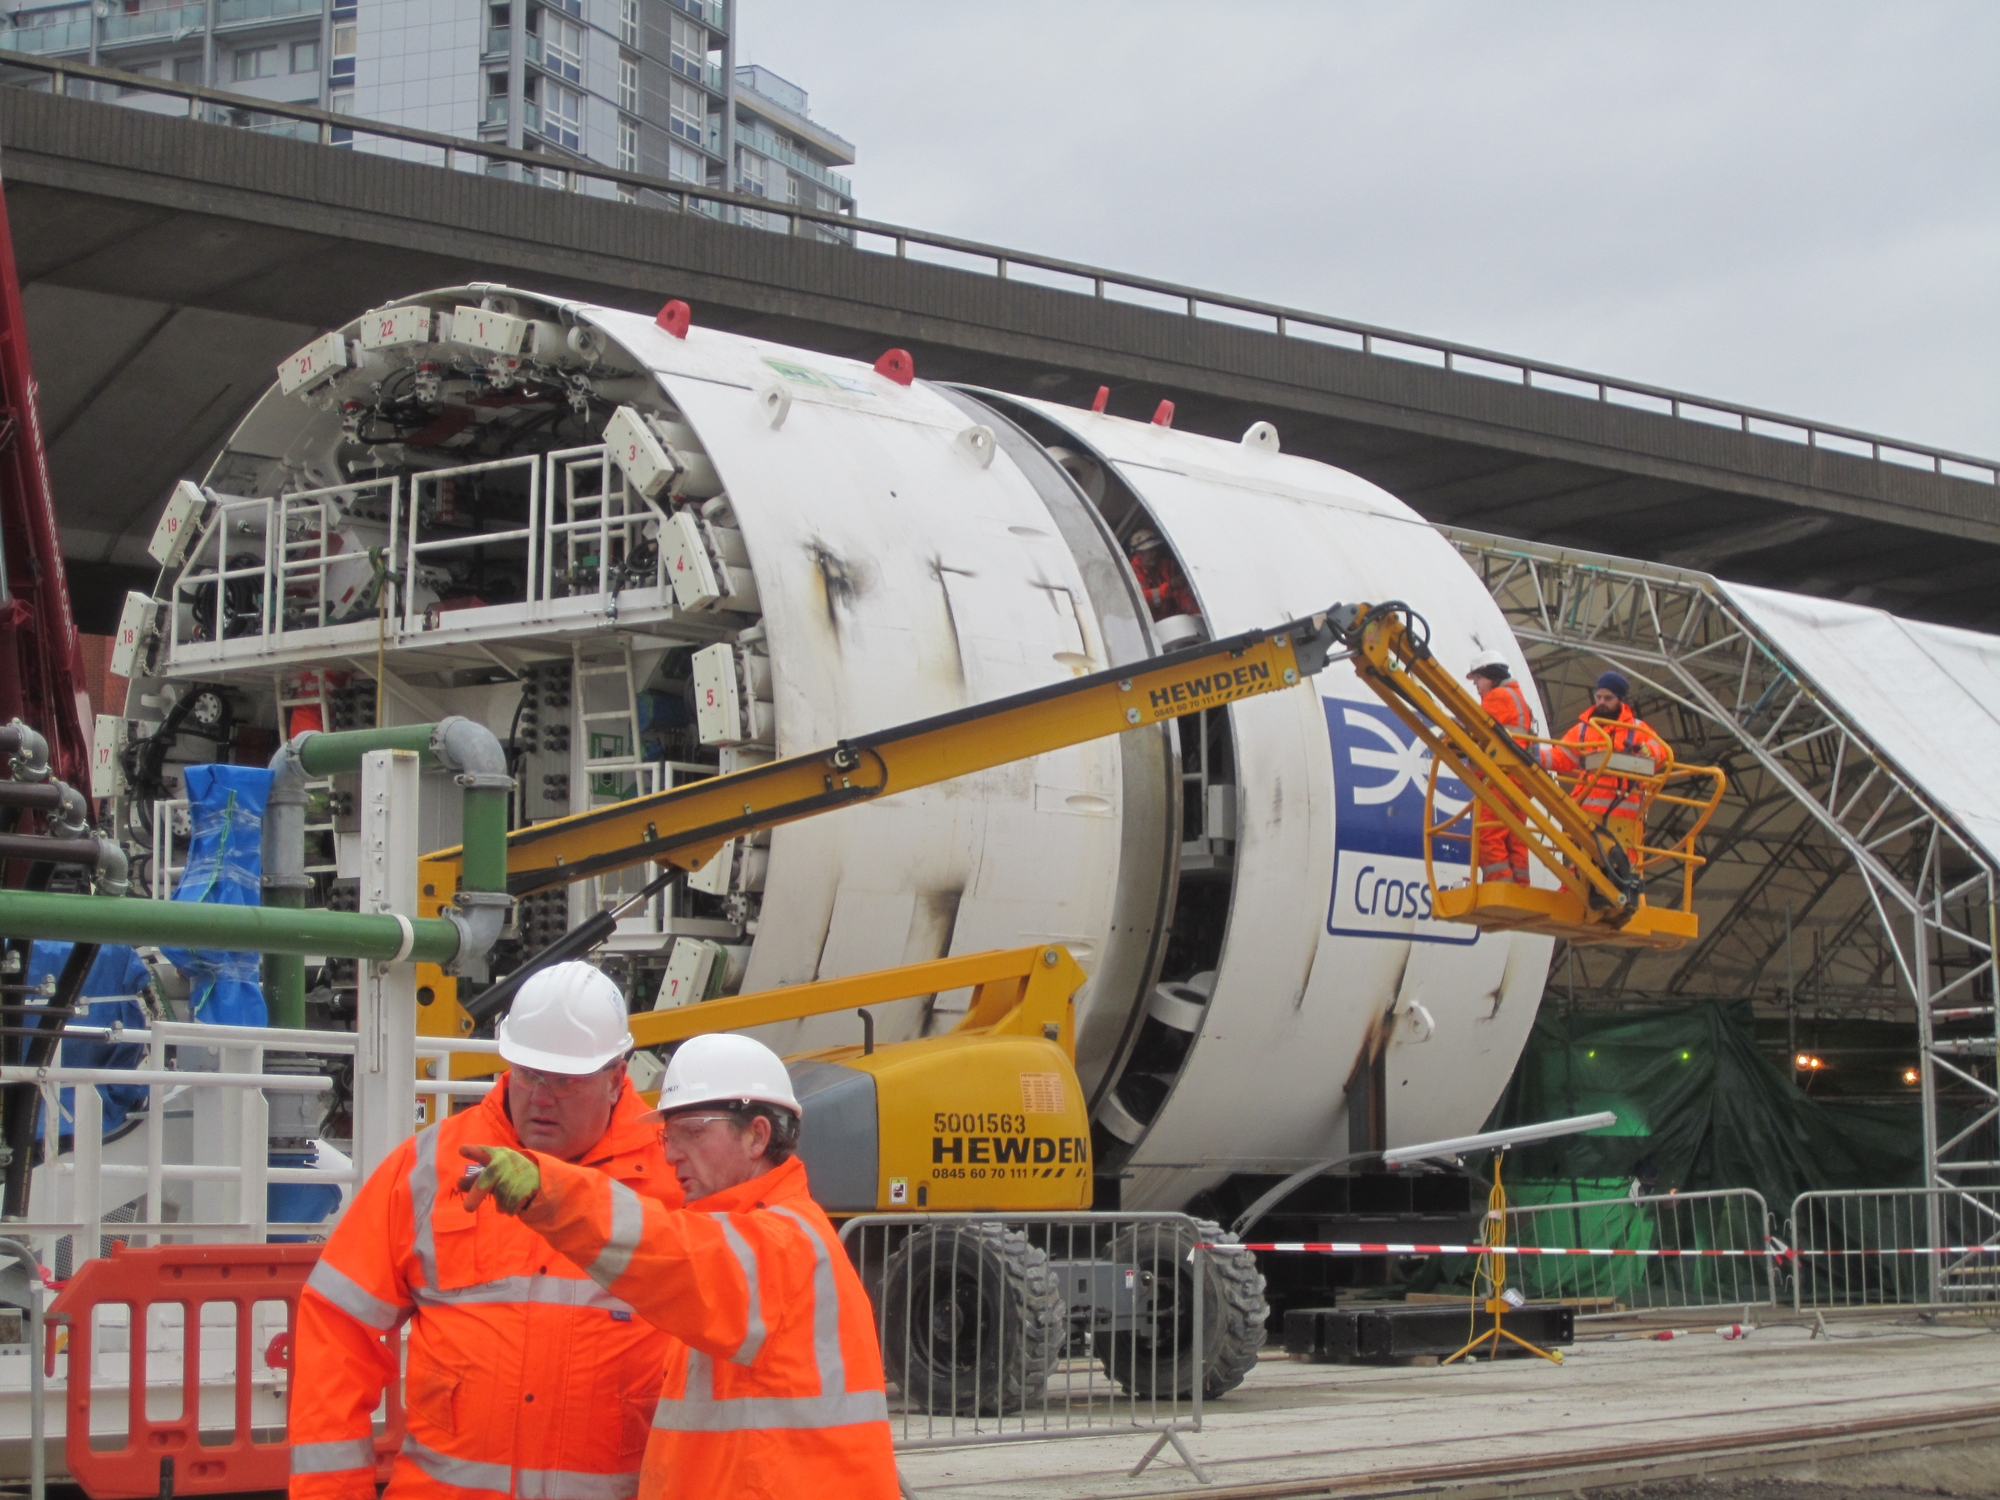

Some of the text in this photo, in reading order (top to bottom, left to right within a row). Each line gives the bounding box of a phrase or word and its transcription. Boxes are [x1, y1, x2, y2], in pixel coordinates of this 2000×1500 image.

[381, 320, 393, 338] 22
[419, 319, 429, 329] 22
[478, 322, 484, 338] 1
[301, 356, 312, 374] 21
[629, 445, 636, 461] 3
[167, 517, 177, 533] 19
[676, 555, 684, 572] 4
[123, 629, 134, 644] 18
[1149, 661, 1270, 708] HEWDEN
[706, 689, 714, 706] 5
[1154, 696, 1215, 717] 0845 60 70 111
[99, 749, 109, 764] 17
[1355, 866, 1453, 921] Cross
[671, 979, 679, 997] 7
[933, 1113, 1026, 1134] 5001563
[932, 1137, 1087, 1164] HEWDEN
[932, 1168, 1027, 1179] 0845 60 70 111
